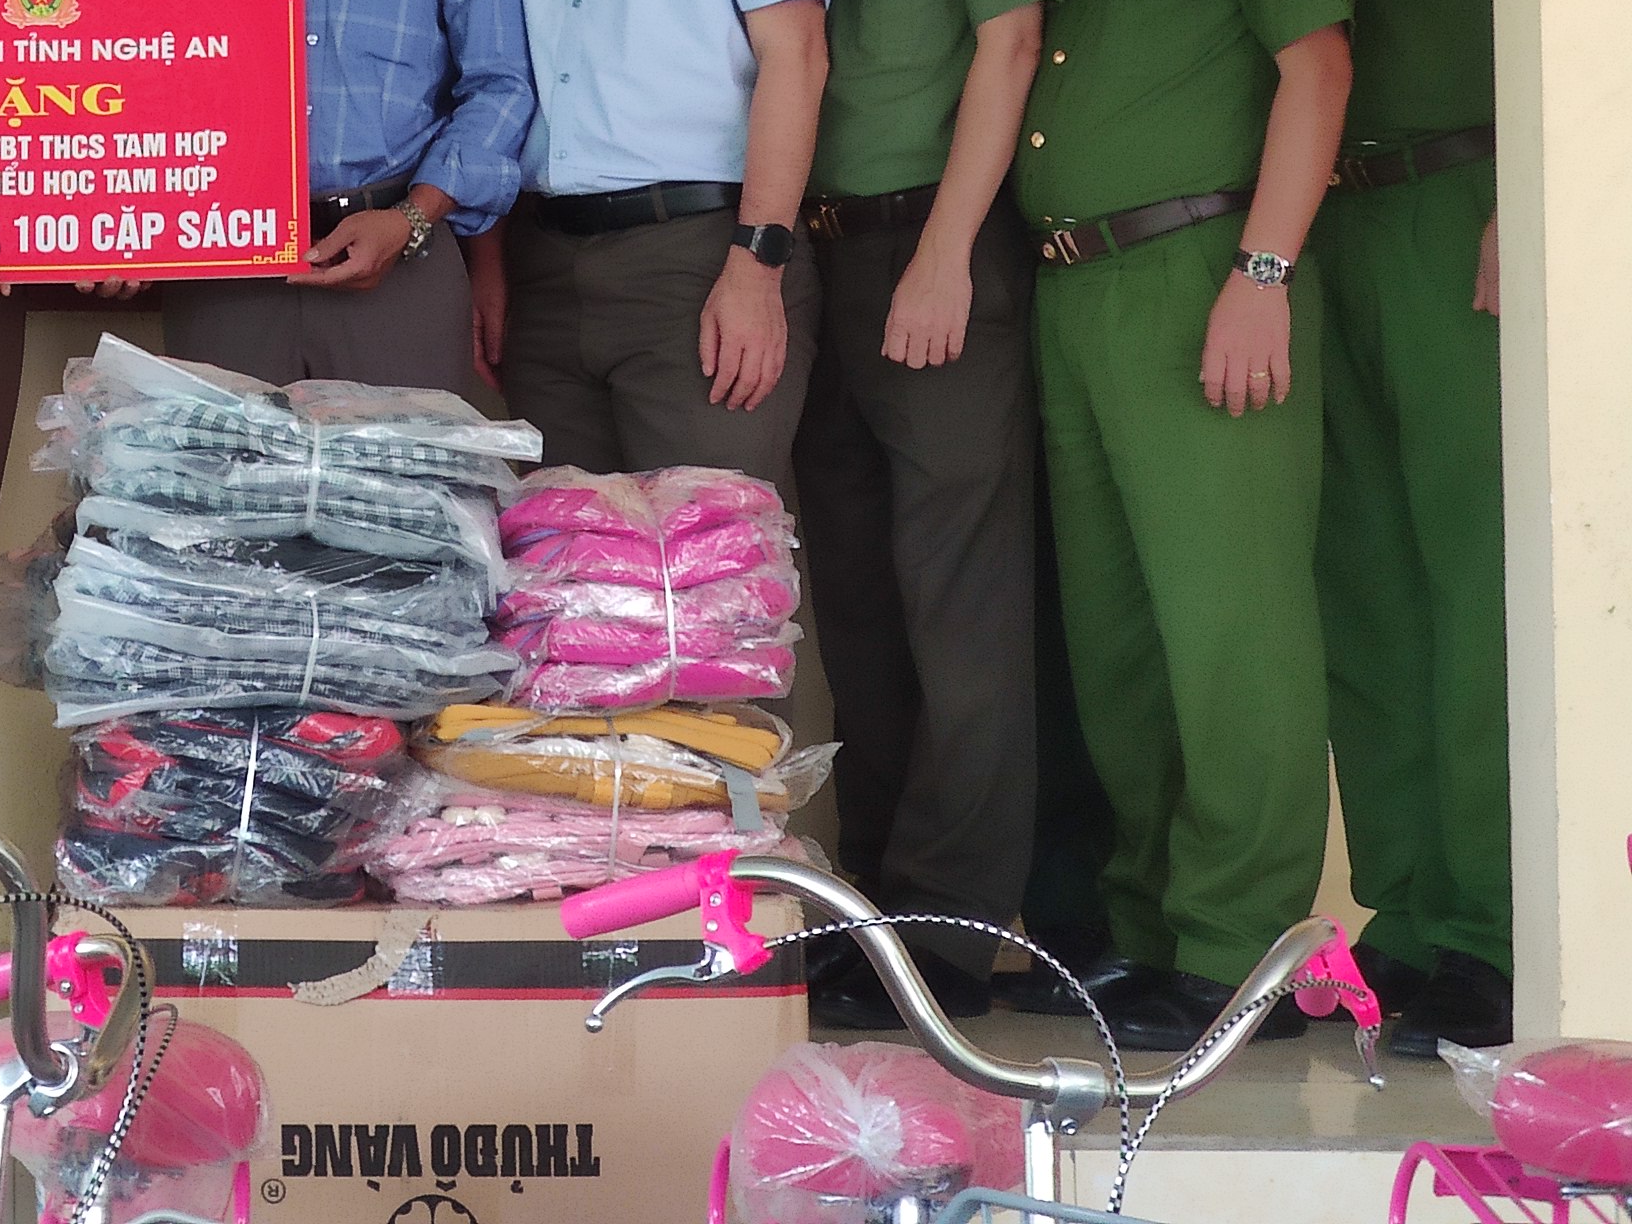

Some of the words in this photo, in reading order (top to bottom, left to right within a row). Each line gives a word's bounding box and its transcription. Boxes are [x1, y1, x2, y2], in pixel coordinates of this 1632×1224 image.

[13, 31, 81, 62] TỈNH
[92, 31, 175, 66] NGHỆ
[184, 36, 229, 58] AN
[39, 133, 105, 159] THCS
[113, 132, 167, 158] TAM
[175, 129, 228, 162] HỢP
[43, 169, 95, 200] HỌC
[103, 168, 156, 194] TAM
[165, 165, 217, 197] HỢP
[14, 212, 79, 253] 100
[91, 204, 163, 259] CẶP
[176, 202, 277, 247] SÁCH
[281, 1124, 422, 1192] VÀNG
